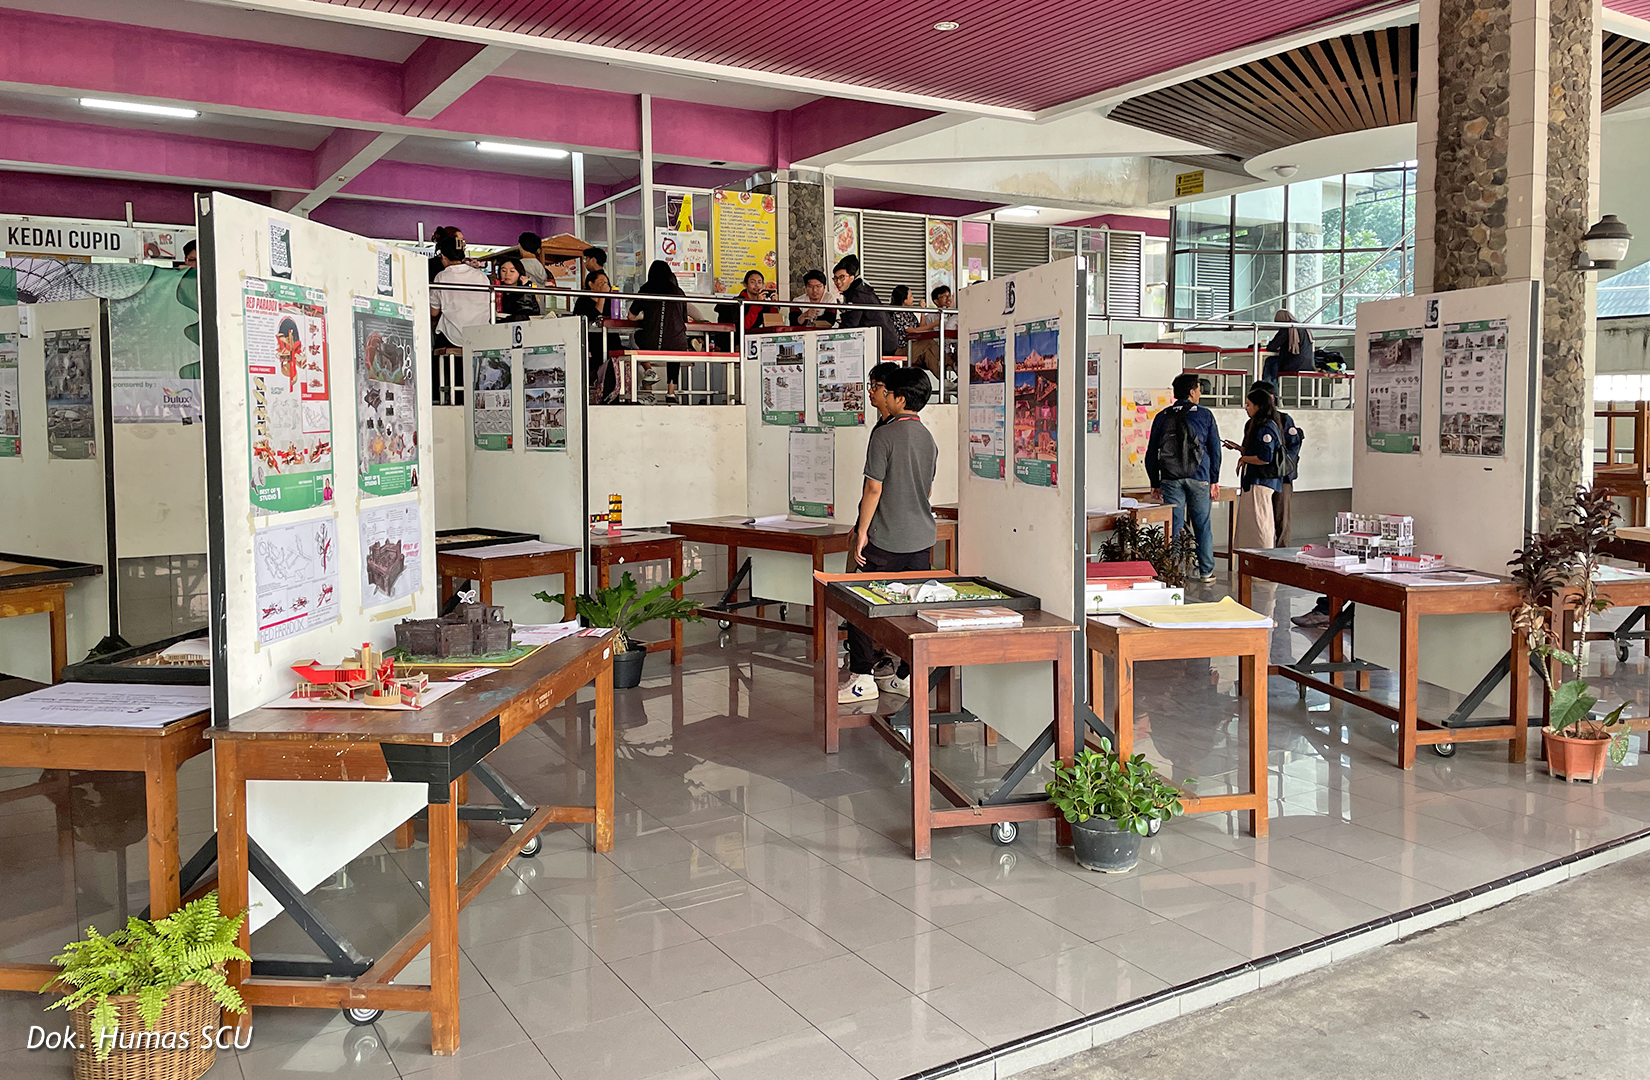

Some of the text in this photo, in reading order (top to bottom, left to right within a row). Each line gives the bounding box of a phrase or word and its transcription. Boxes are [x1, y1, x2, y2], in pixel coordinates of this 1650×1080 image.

[8, 226, 120, 251] KEDAI CUPID
[280, 229, 291, 268] 1
[385, 254, 392, 287] 1
[246, 296, 278, 312] RED PARADOX
[1008, 280, 1016, 309] 6
[1430, 300, 1438, 322] 5
[515, 326, 522, 344] 6
[750, 340, 758, 356] 5
[163, 395, 189, 404] Dulux
[260, 628, 274, 643] RED
[274, 617, 305, 640] PARADOX
